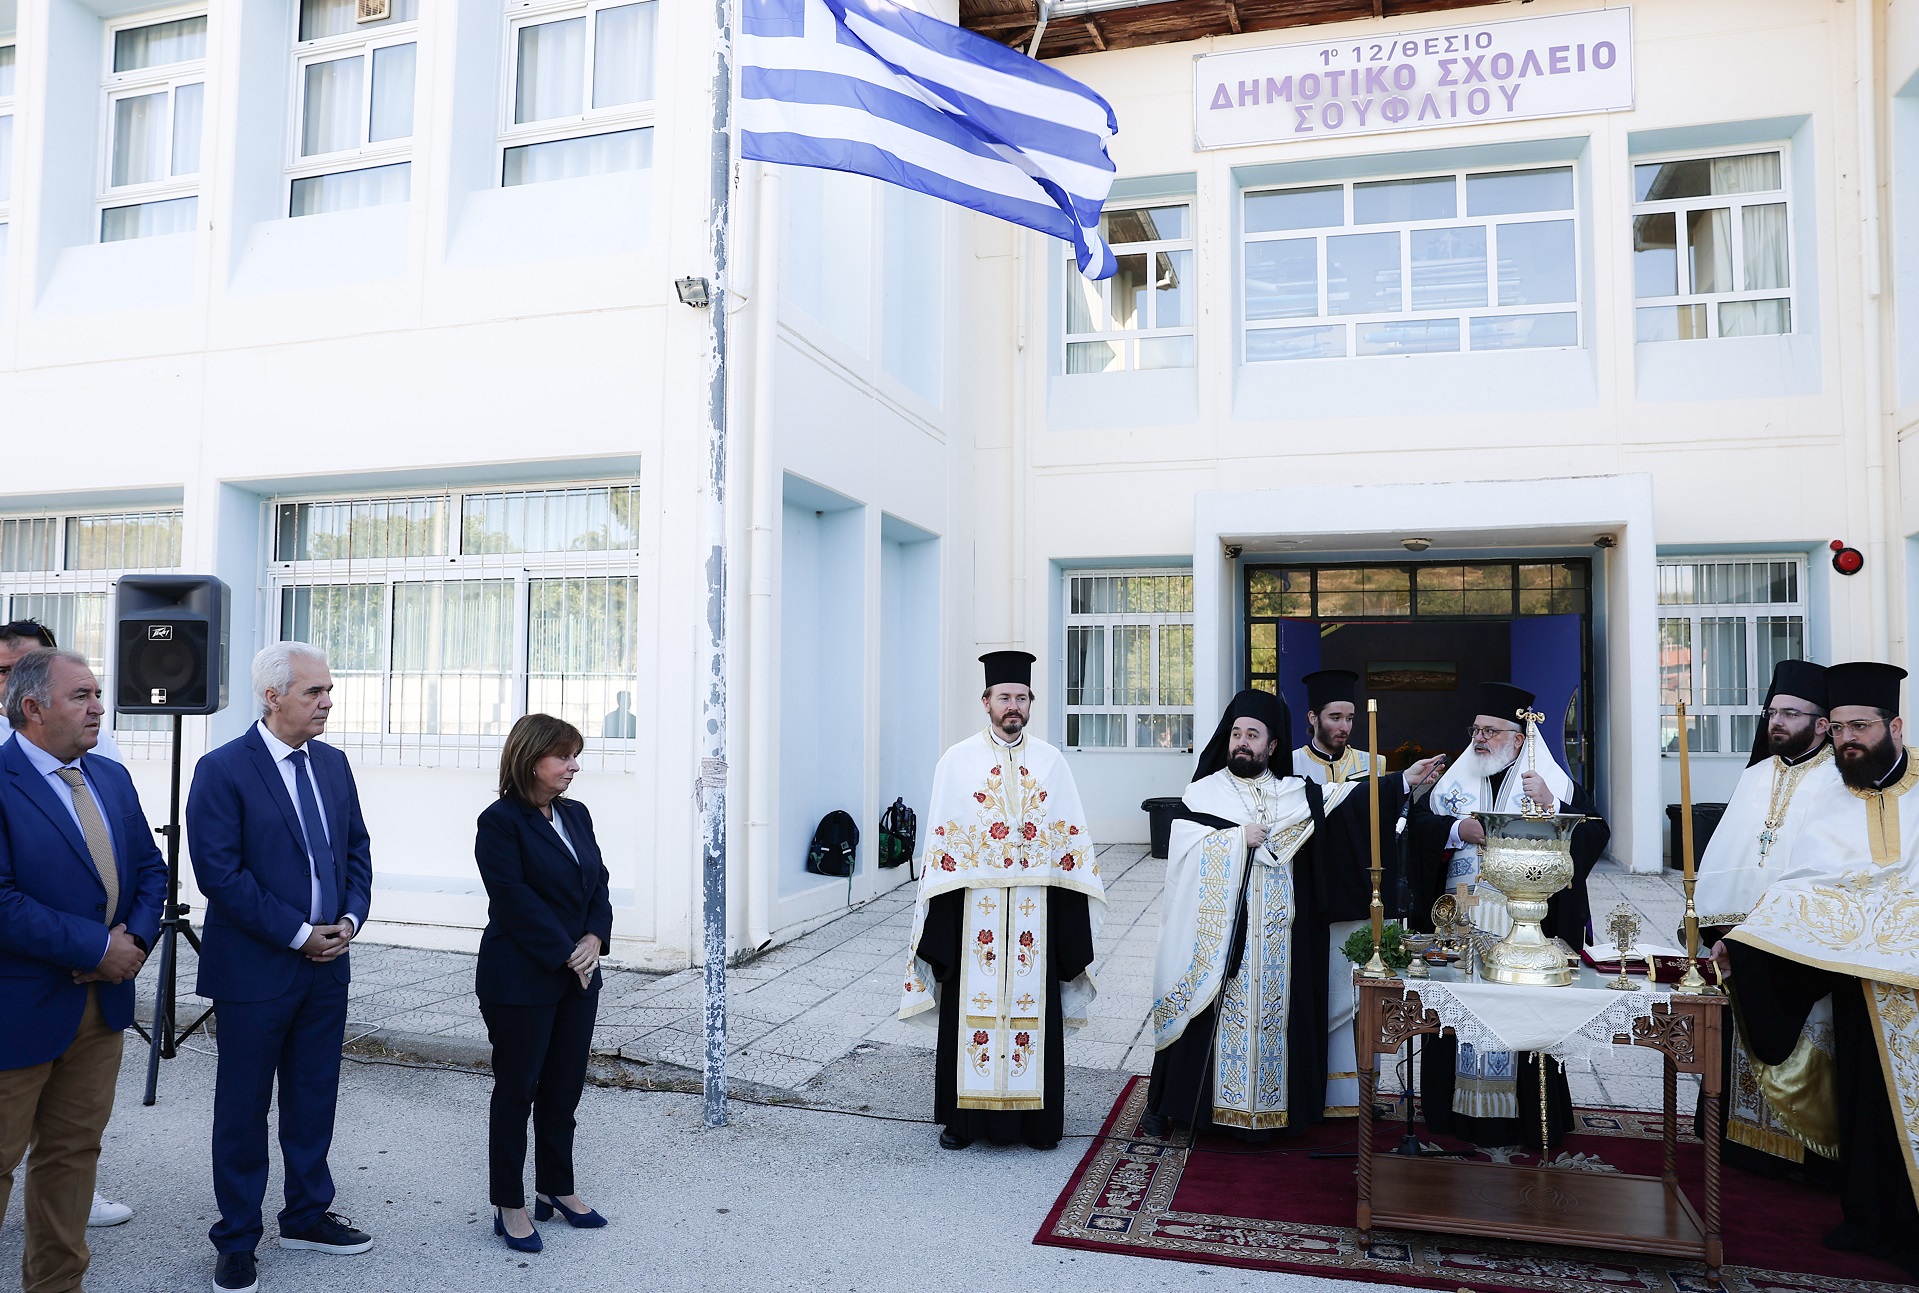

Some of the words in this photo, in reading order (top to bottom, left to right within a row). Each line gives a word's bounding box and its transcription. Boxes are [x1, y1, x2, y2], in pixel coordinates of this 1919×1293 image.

[1351, 31, 1493, 63] 12/ΘΕΣΙΟ
[1209, 63, 1416, 111] ΔΗΜΟΤΙΚΟ
[1437, 40, 1617, 87] ΣΧΟΛΕΙΟ
[1294, 83, 1522, 133] ΣΟΥΦΛΙΟΥ
